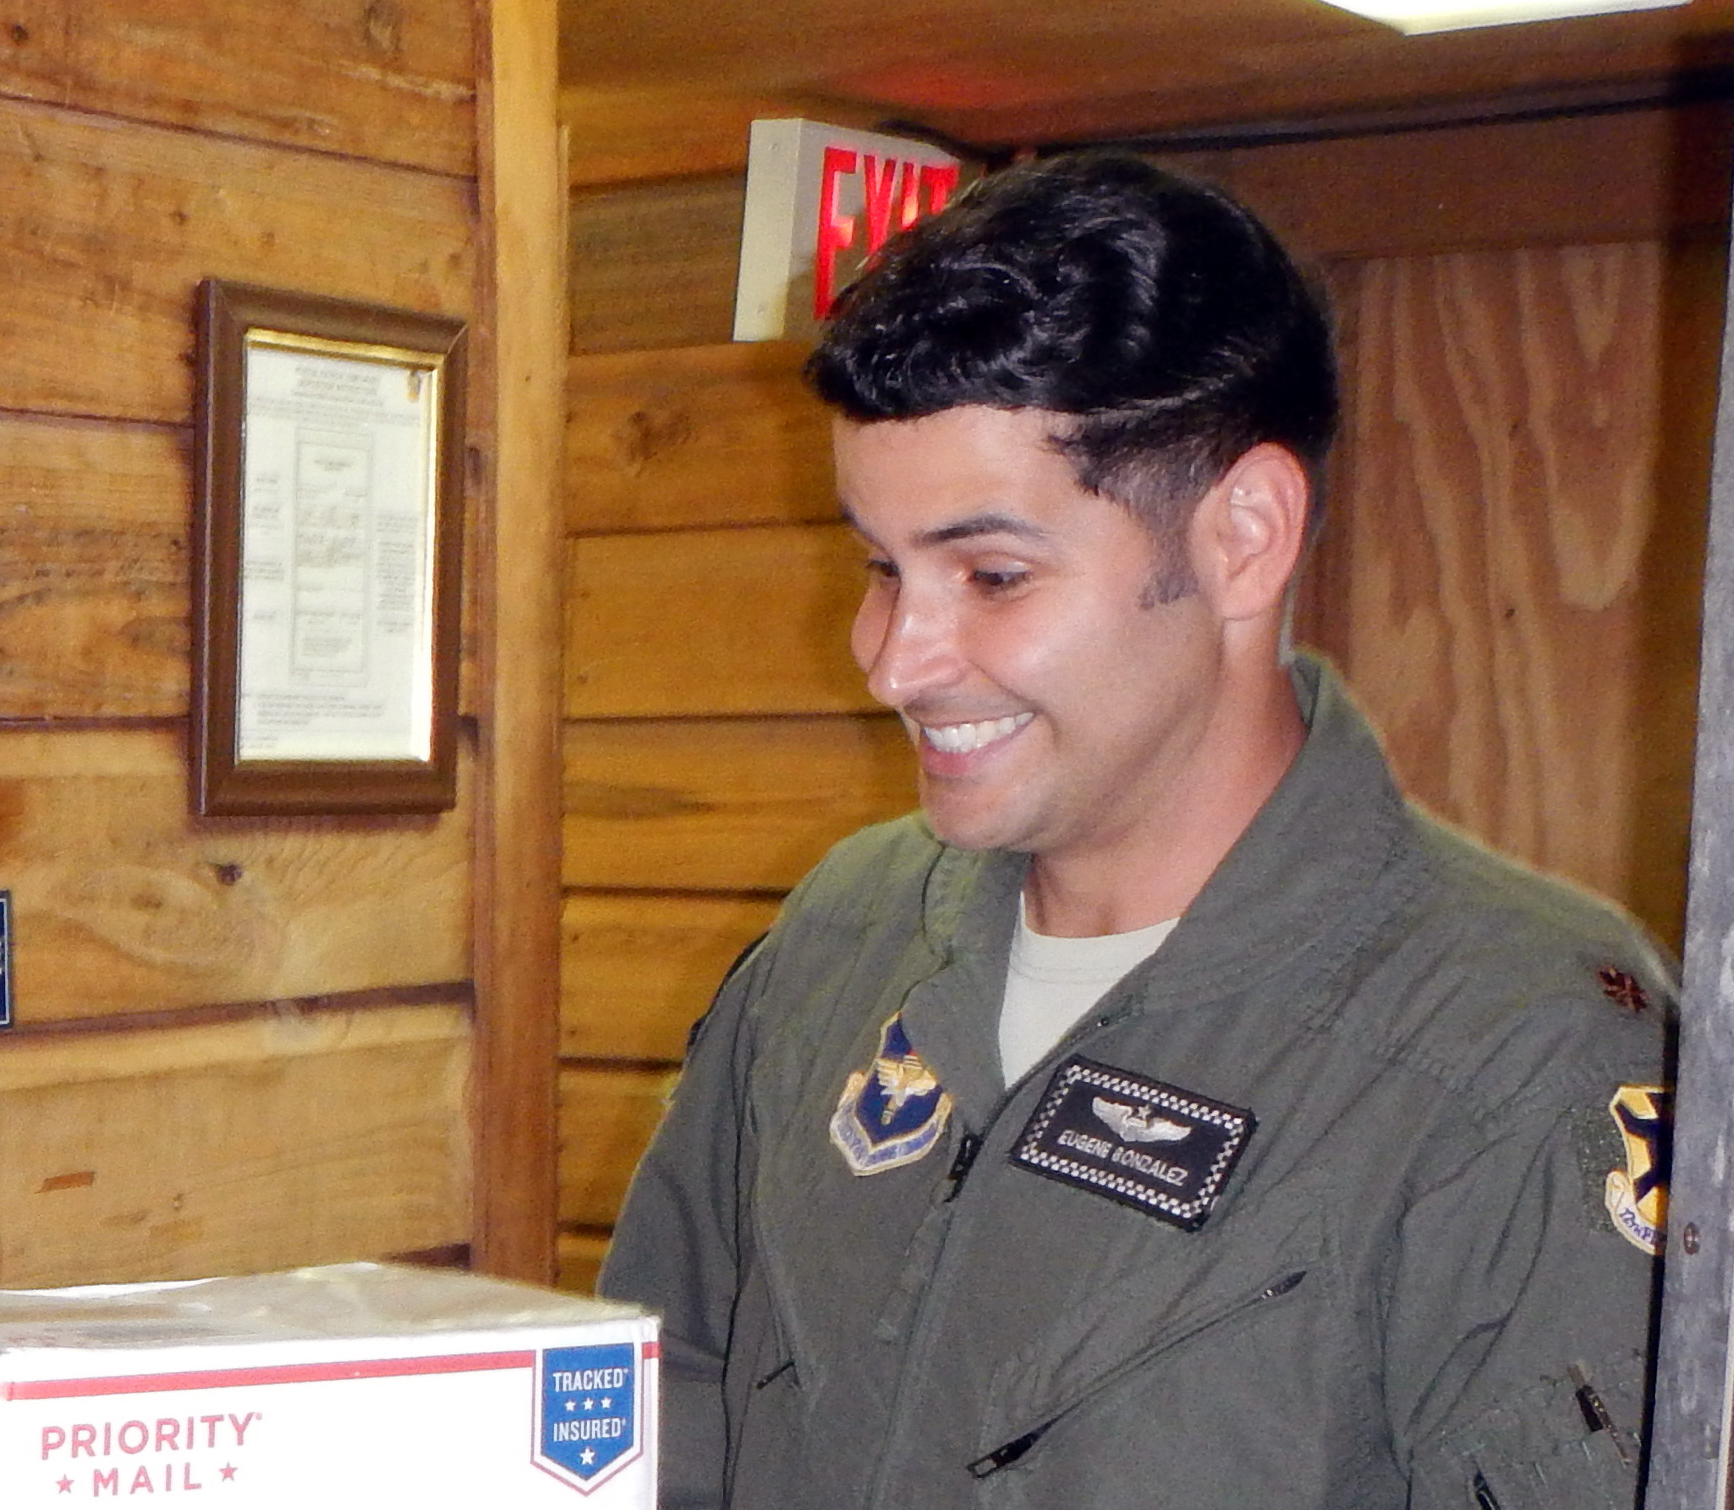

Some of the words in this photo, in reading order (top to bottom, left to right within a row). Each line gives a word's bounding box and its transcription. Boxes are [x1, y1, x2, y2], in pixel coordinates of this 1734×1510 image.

[1057, 1129, 1110, 1160] EUGENE
[1111, 1144, 1189, 1188] GONZALEZ
[552, 1367, 624, 1393] TRACKED
[40, 1411, 254, 1461] PRIORITY
[552, 1418, 624, 1442] INSURED
[92, 1460, 202, 1498] MAIL
